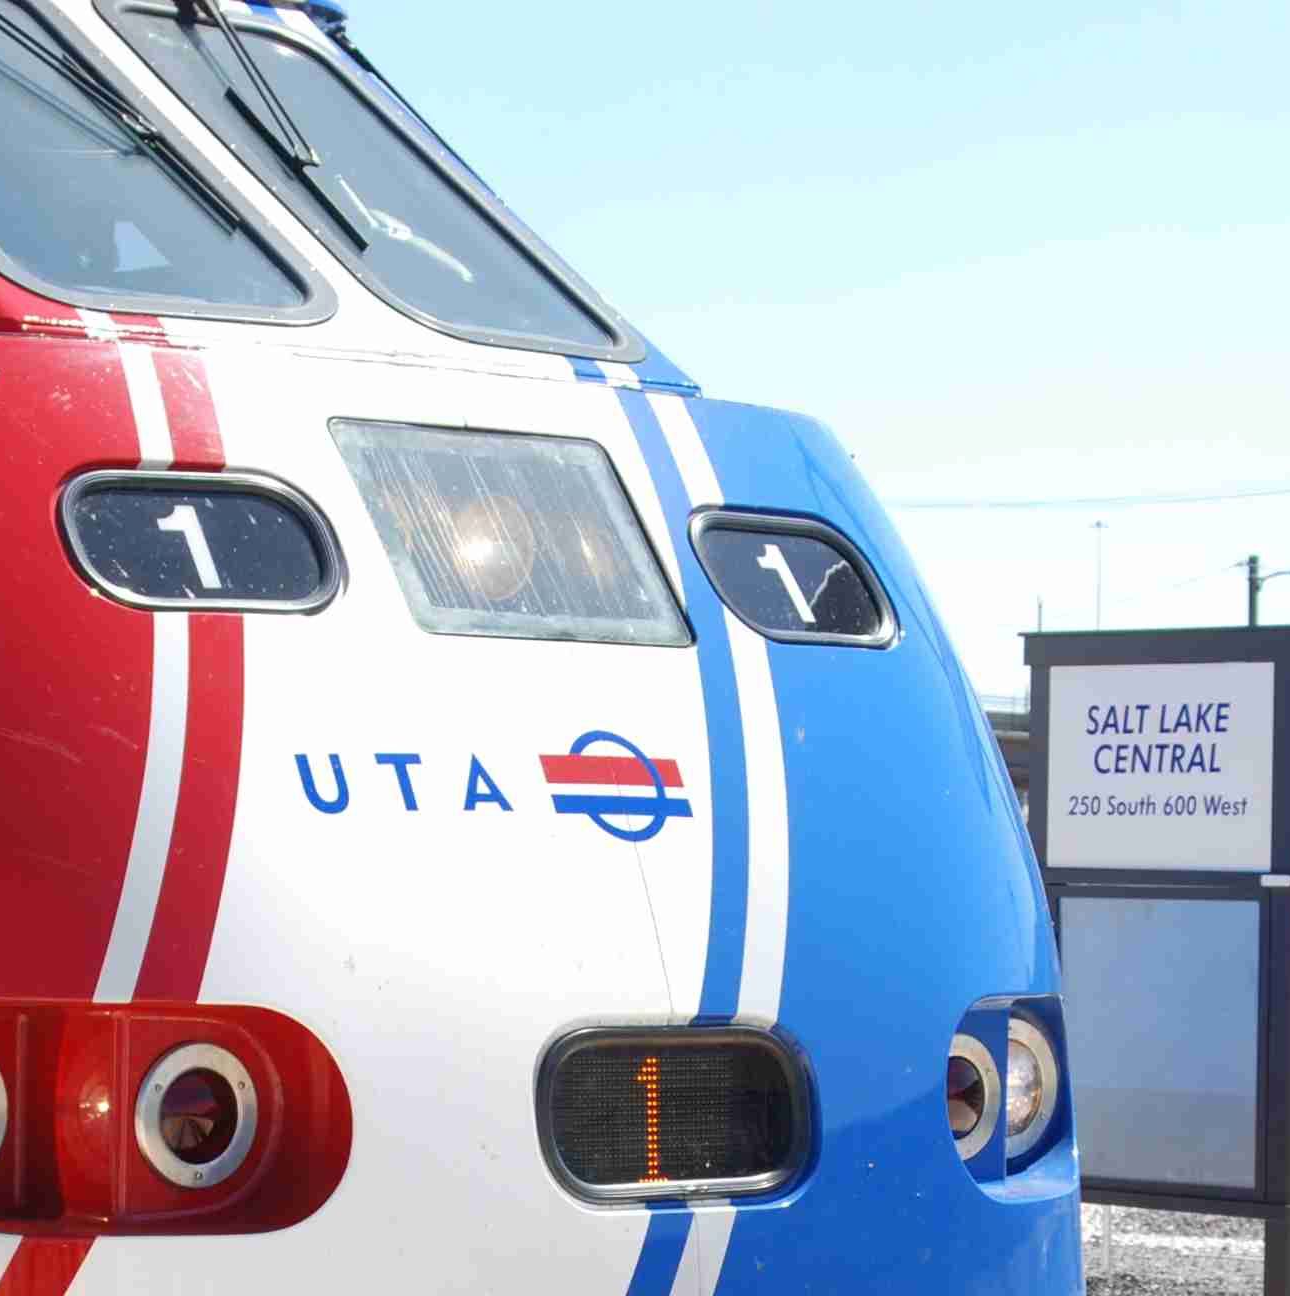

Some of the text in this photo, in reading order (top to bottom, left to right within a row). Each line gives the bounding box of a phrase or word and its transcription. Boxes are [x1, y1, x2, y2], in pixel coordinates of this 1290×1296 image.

[156, 504, 222, 589] 1
[756, 542, 817, 624] 1
[1086, 702, 1231, 736] SALT LAKE
[1093, 743, 1222, 775] CENTRAL
[294, 752, 514, 815] UTA
[1068, 794, 1248, 817] 250 South 600 West
